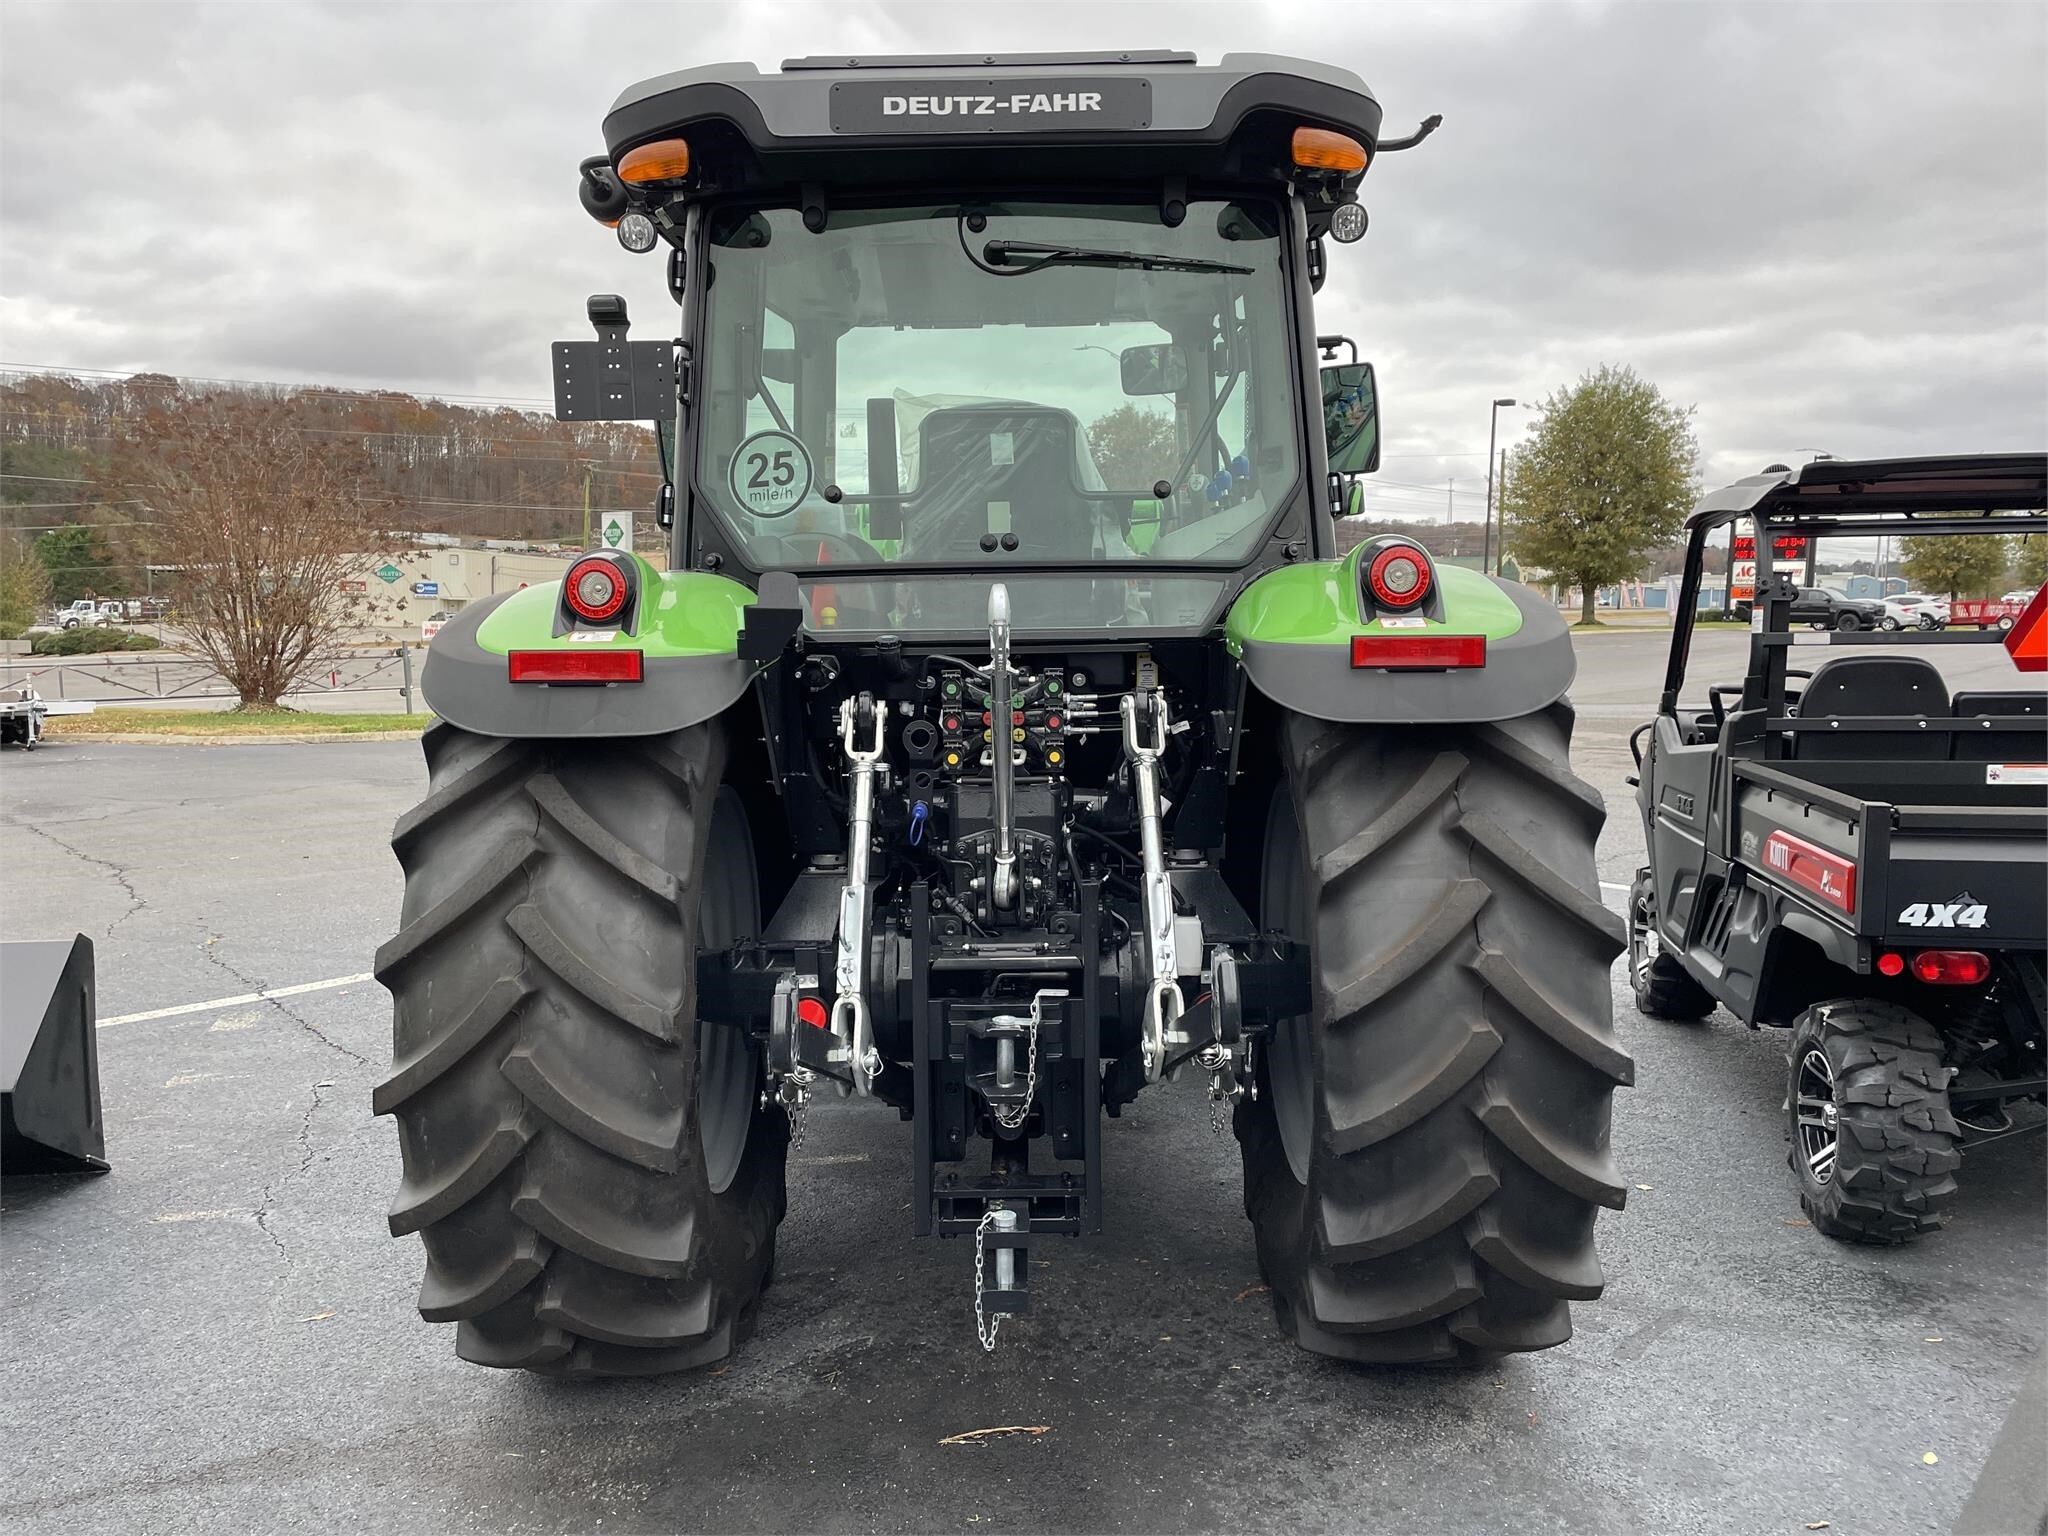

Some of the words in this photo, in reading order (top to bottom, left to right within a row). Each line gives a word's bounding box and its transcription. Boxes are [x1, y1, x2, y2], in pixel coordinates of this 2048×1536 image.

[882, 92, 1102, 115] DEUTZ-FAHR
[747, 450, 795, 489] 25
[749, 487, 794, 502] mile/h
[1736, 565, 1755, 577] AC
[1769, 839, 1789, 871] KIOTI
[1898, 903, 1988, 928] 4X4
